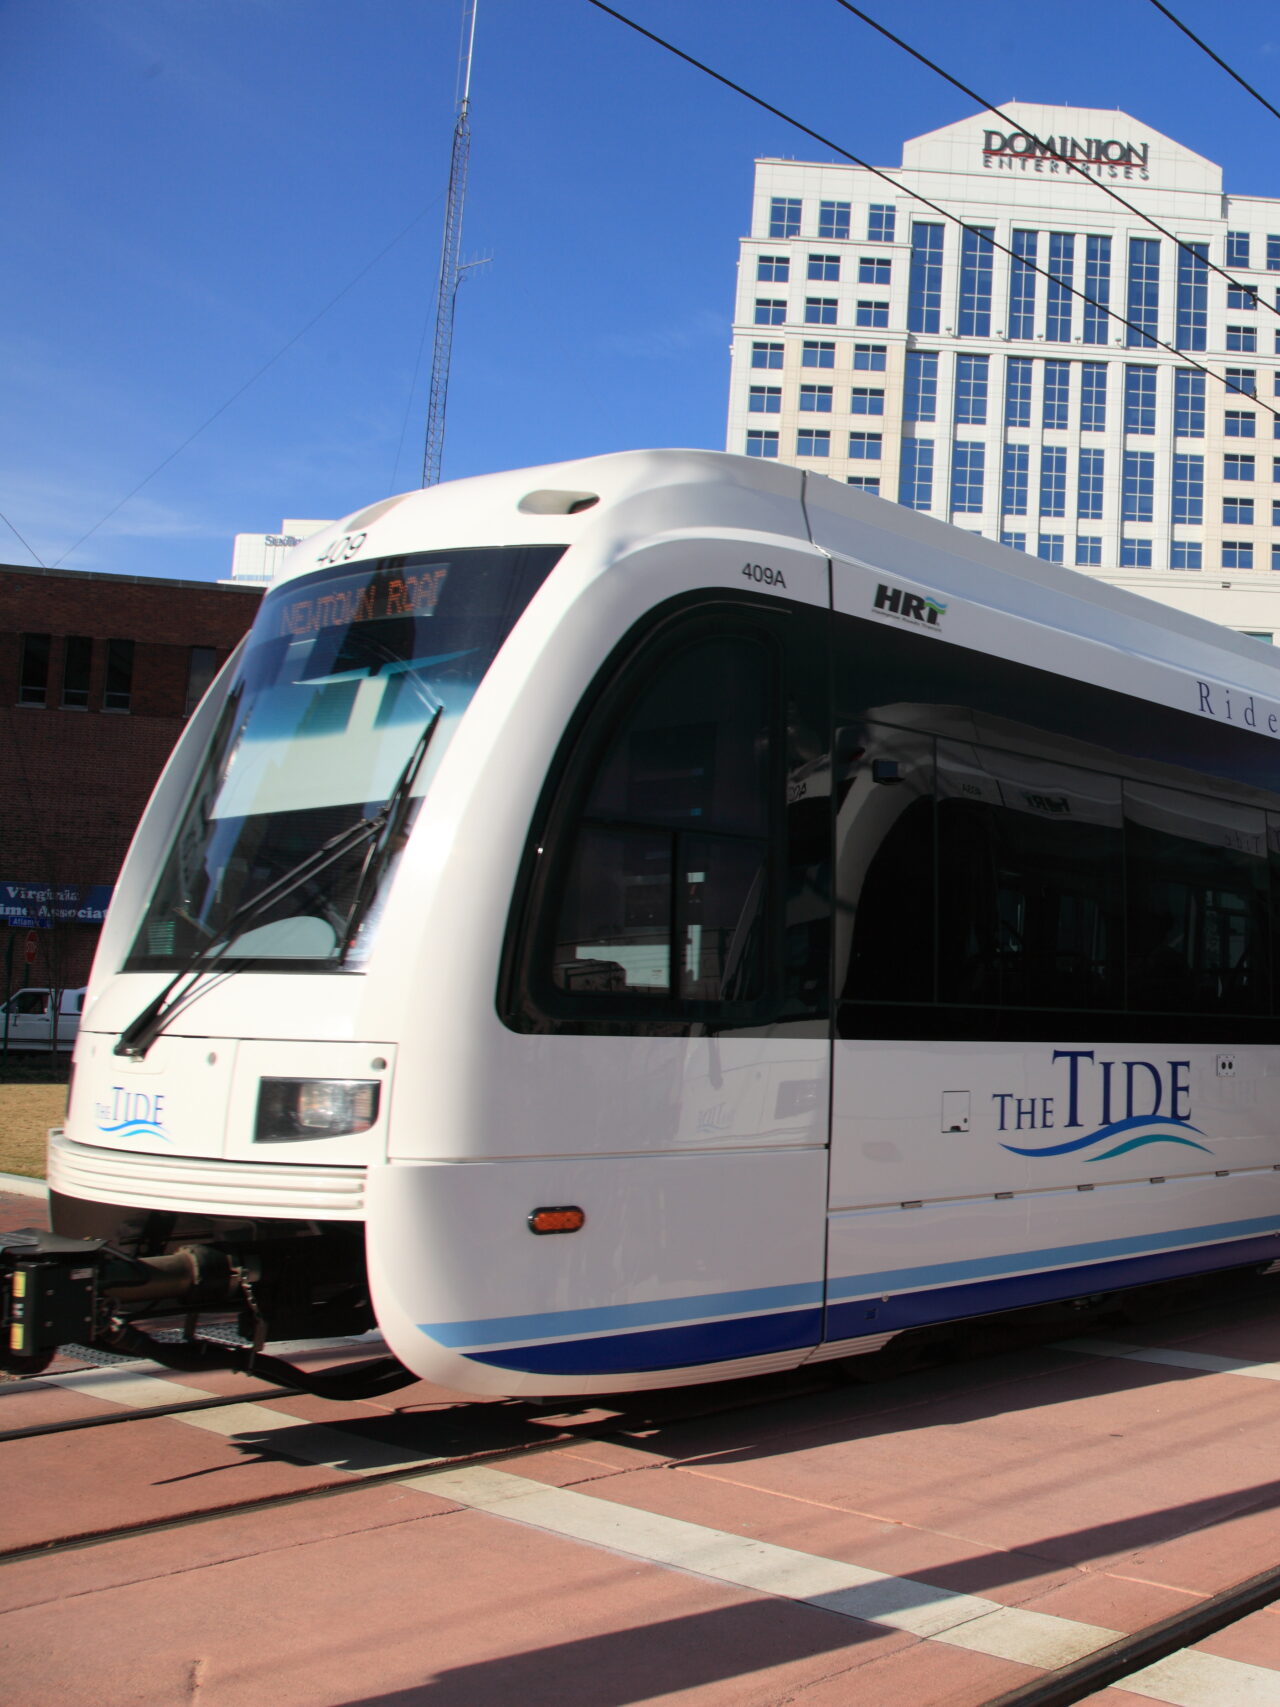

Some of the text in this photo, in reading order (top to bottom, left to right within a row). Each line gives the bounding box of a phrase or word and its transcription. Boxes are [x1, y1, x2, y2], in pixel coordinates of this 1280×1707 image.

[983, 129, 1149, 167] DOMINION
[983, 154, 1150, 182] ENTERPRISES
[316, 532, 368, 564] 409
[742, 563, 787, 589] 409A
[280, 585, 377, 635] NEWTOWN
[873, 583, 948, 626] HRT
[1197, 681, 1277, 733] Ride
[112, 1086, 165, 1126] TIDE
[992, 1049, 1192, 1131] THE TIDE
